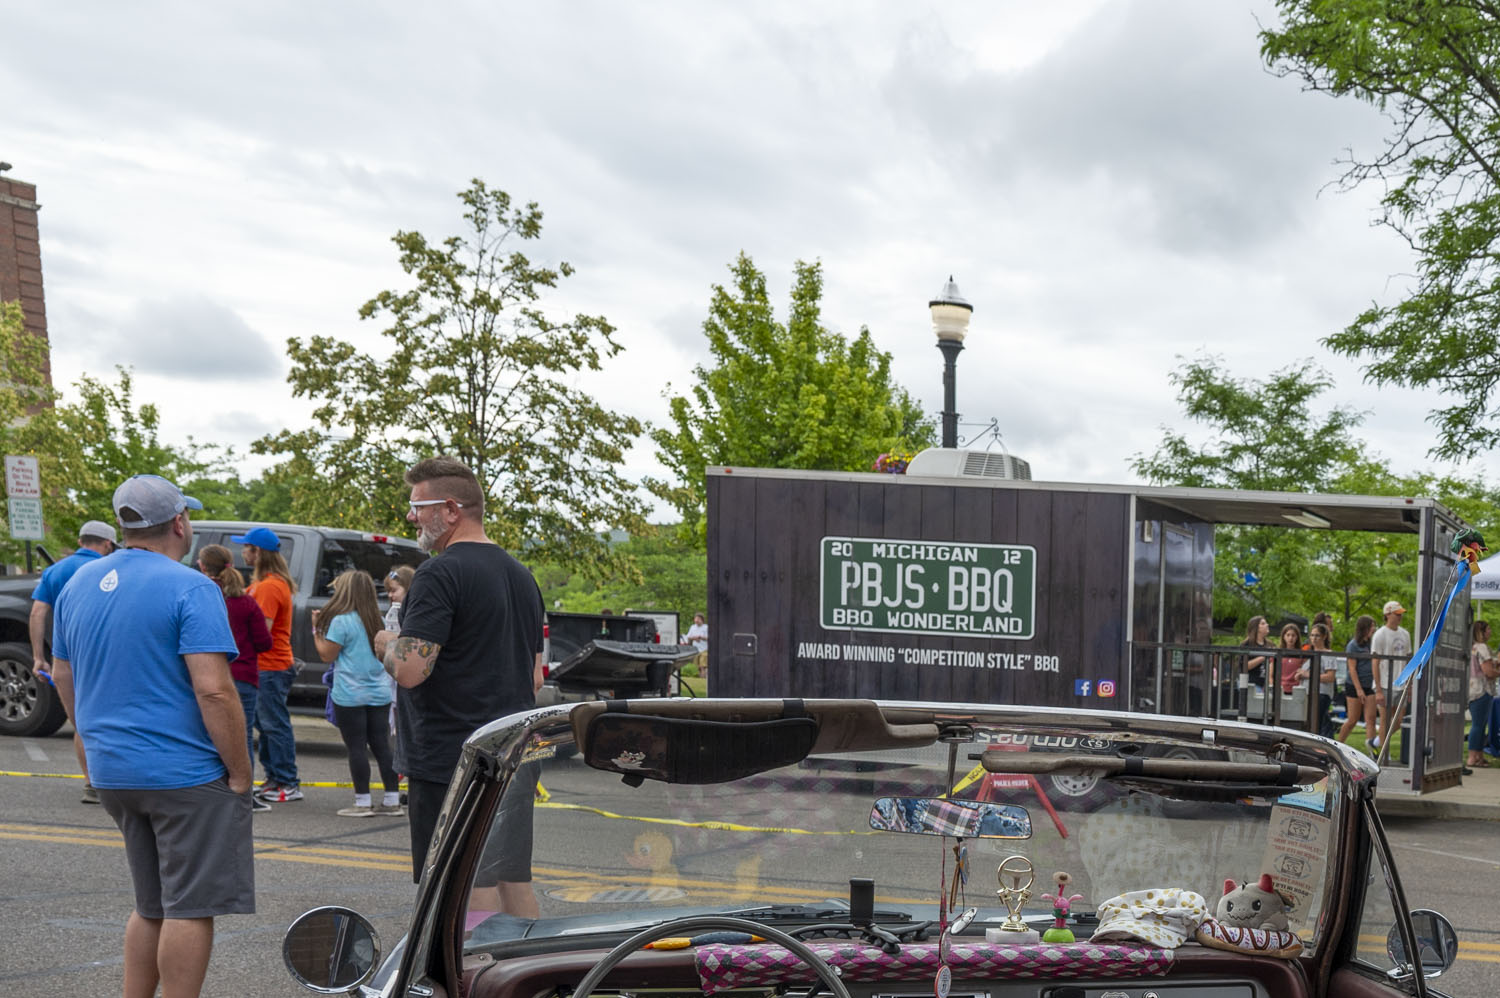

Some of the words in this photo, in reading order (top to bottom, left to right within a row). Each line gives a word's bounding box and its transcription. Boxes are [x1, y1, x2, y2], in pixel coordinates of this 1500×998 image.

[831, 541, 853, 557] 20
[872, 543, 979, 563] MICHIGAN
[1003, 550, 1022, 565] 12
[840, 560, 926, 609] PBJS
[948, 565, 1014, 614] BBQ
[1474, 580, 1500, 591] Boldly
[832, 608, 874, 626] BBQ
[887, 610, 1023, 634] WONDERLAND
[797, 642, 841, 660] AWARD
[843, 645, 896, 663] WINNING
[898, 648, 985, 669] "COMPETITION
[987, 654, 1032, 671] STYLE"
[1034, 655, 1060, 673] BBQ
